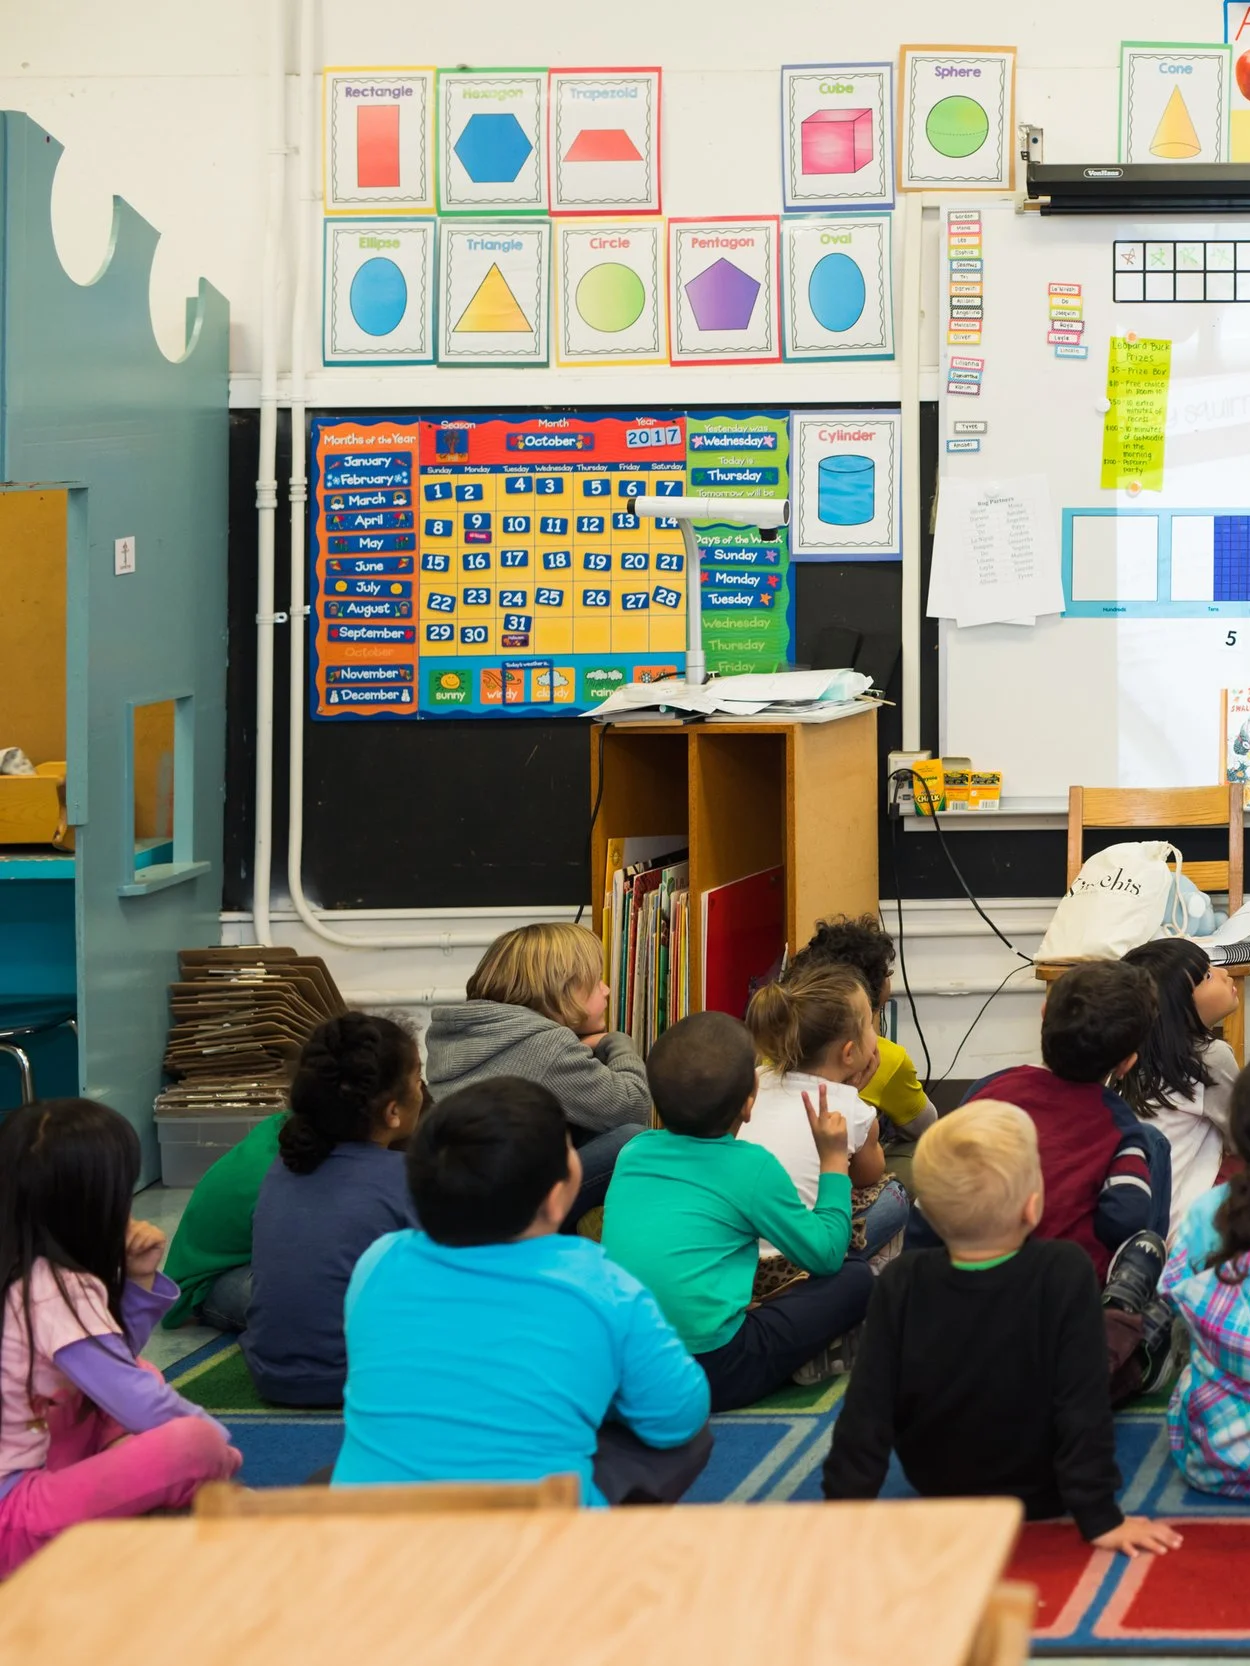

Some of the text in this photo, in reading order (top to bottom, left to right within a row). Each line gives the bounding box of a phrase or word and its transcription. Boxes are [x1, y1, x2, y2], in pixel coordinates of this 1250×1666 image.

[934, 65, 982, 80] Sphere
[1158, 62, 1193, 75] Cone
[345, 86, 413, 98] Rectangle
[462, 88, 523, 101] Hexagon
[570, 87, 638, 101] Trapezoid
[819, 82, 854, 95] Cube
[358, 236, 400, 251] Ellipse
[466, 237, 523, 253] Triangle
[589, 235, 630, 250] Circle
[691, 236, 755, 251] Pentagon
[819, 231, 852, 246] Oval
[1112, 341, 1170, 351] Leopard Buck
[1126, 353, 1154, 362] Prizes
[1128, 367, 1148, 375] Prize
[440, 421, 476, 430] Season
[538, 418, 569, 428] Month
[635, 417, 657, 426] Year
[704, 424, 749, 433] Yesterday
[324, 433, 416, 445] Months of the Year
[525, 435, 576, 448] October
[703, 436, 764, 447] Wednesday
[818, 430, 876, 443] Cylinder
[344, 456, 392, 468] January
[619, 463, 641, 472] Friday
[651, 462, 683, 471] Saturday
[720, 457, 754, 466] Today is
[503, 465, 529, 473] Tuesday
[535, 464, 573, 473] Wednesday
[577, 464, 608, 473] Thursday
[340, 473, 394, 486] February
[707, 470, 762, 481] Thursday
[434, 485, 442, 498] 1
[545, 479, 555, 493] 3
[591, 480, 602, 495] 5
[664, 482, 675, 495] 7
[349, 492, 386, 506] March
[355, 515, 383, 528] April
[433, 521, 443, 535] 8
[507, 518, 526, 531] 10
[581, 518, 599, 531] 12
[359, 538, 383, 550] May
[722, 536, 733, 544] of
[735, 534, 749, 543] the
[468, 555, 486, 568] 16
[548, 553, 566, 567] 18
[660, 555, 678, 569] 21
[714, 550, 757, 562] Sunday
[355, 561, 384, 572] June
[716, 573, 760, 586] Monday
[356, 582, 381, 595] July
[502, 592, 523, 606] 24
[708, 593, 754, 606] Tuesday
[347, 603, 390, 617] August
[508, 616, 525, 631] 31
[703, 618, 771, 629] Wednesday
[339, 627, 404, 640] September
[1225, 630, 1237, 646] 5
[345, 647, 395, 657] October
[708, 640, 765, 651] Thursday
[341, 667, 398, 679] November
[718, 661, 755, 674] Friday
[341, 688, 399, 700] December
[436, 691, 466, 702] sunny
